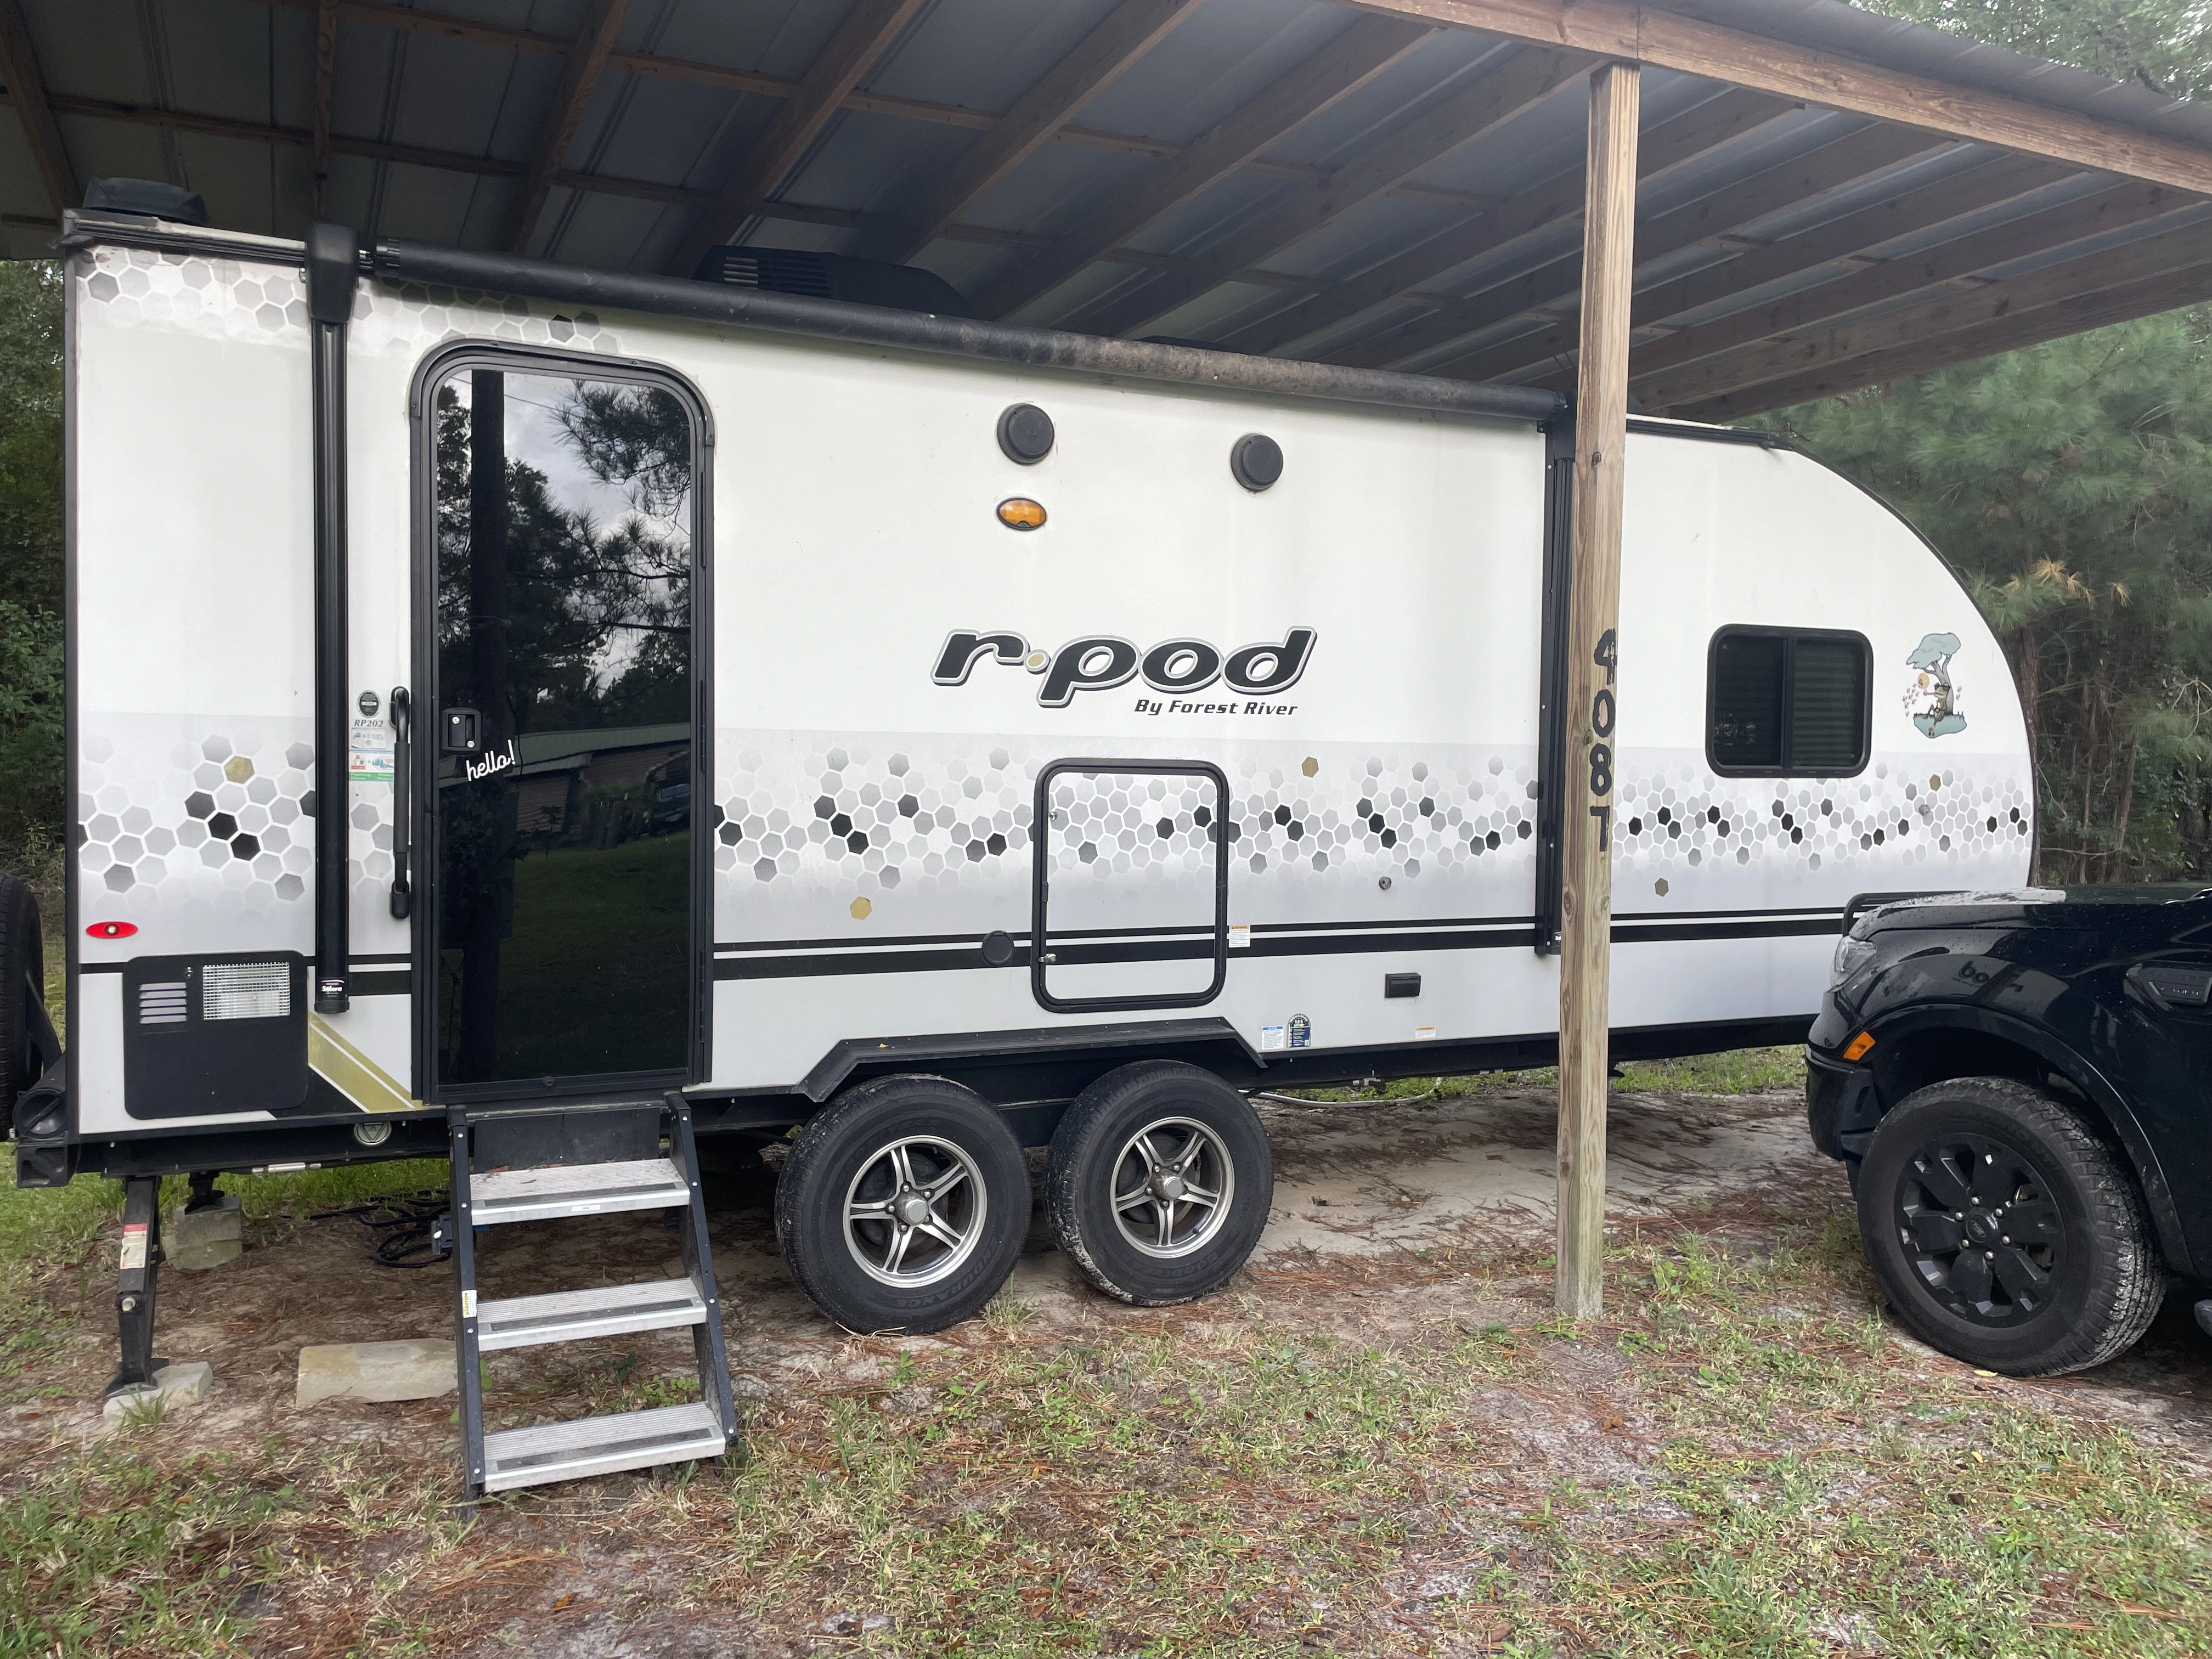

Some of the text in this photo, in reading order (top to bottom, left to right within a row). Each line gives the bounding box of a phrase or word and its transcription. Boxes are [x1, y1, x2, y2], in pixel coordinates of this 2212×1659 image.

[1134, 699, 1298, 716] By Forest River
[466, 739, 516, 782] hello!
